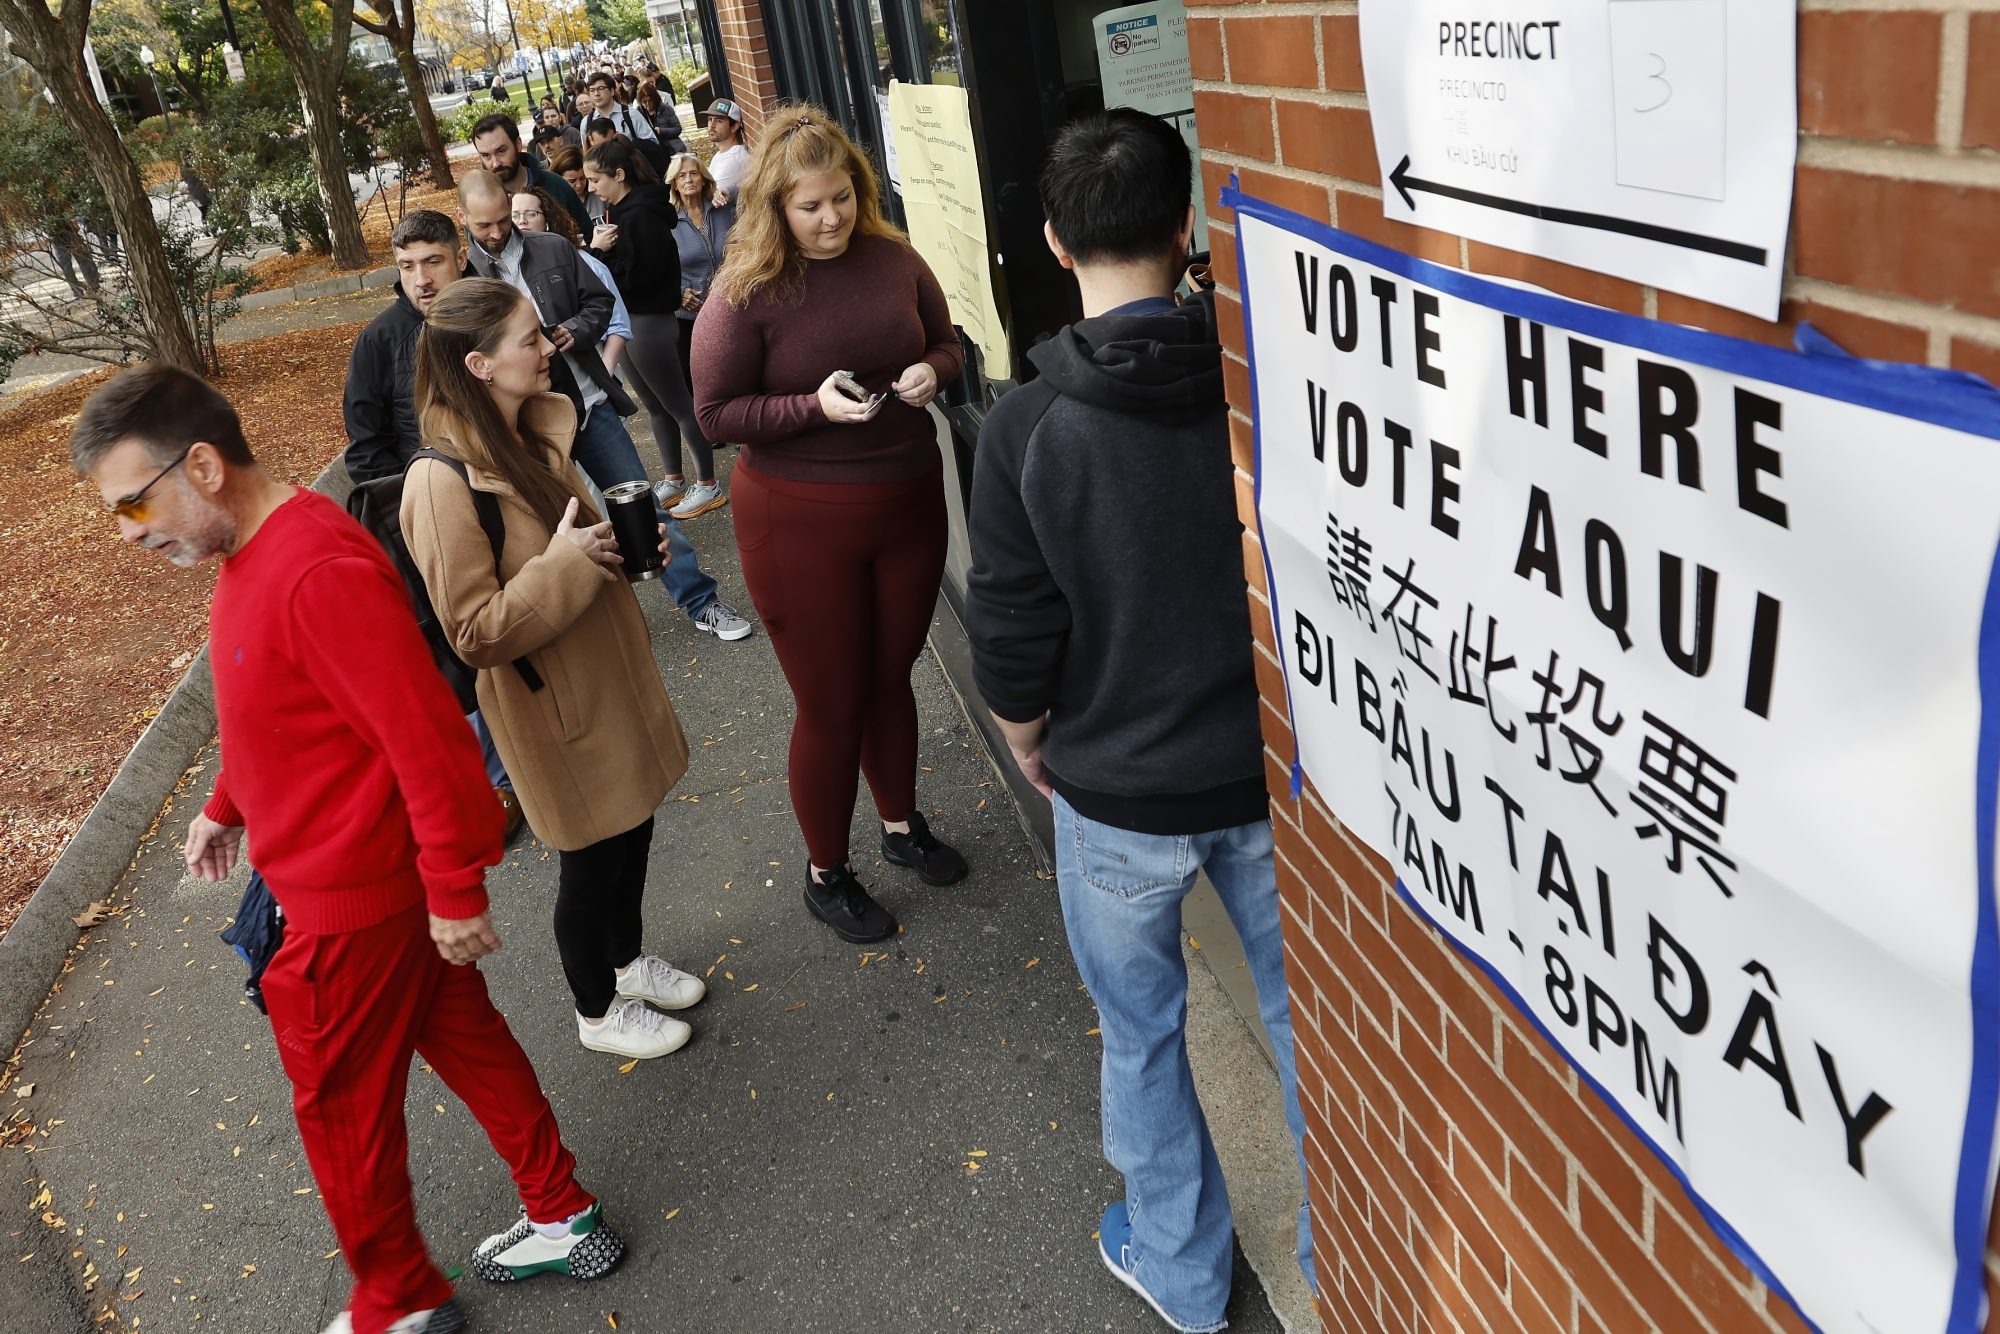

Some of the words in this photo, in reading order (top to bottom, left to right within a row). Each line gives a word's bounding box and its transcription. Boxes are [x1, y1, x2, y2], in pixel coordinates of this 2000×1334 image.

[1116, 19, 1149, 32] NOTICE
[1133, 38, 1158, 48] parking
[1438, 20, 1560, 61] PRECINCT
[1118, 77, 1147, 87] PARKING
[1147, 70, 1174, 81] PERMITS
[1439, 78, 1507, 102] PRECINCTO
[1633, 51, 1674, 113] 3
[1294, 250, 1447, 391] VOTE
[1503, 313, 1792, 531] HERE
[1306, 379, 1461, 542] VOTE
[1513, 484, 1783, 722] AQUI
[1326, 511, 1738, 899] 請在此投票
[1294, 609, 1338, 707] ĐI
[1354, 657, 1462, 823] BẦU
[1484, 774, 1617, 960] TẠI
[1646, 911, 1895, 1179] ĐÂY
[1384, 780, 1485, 936] 7AM
[1543, 944, 1686, 1148] 8PM
